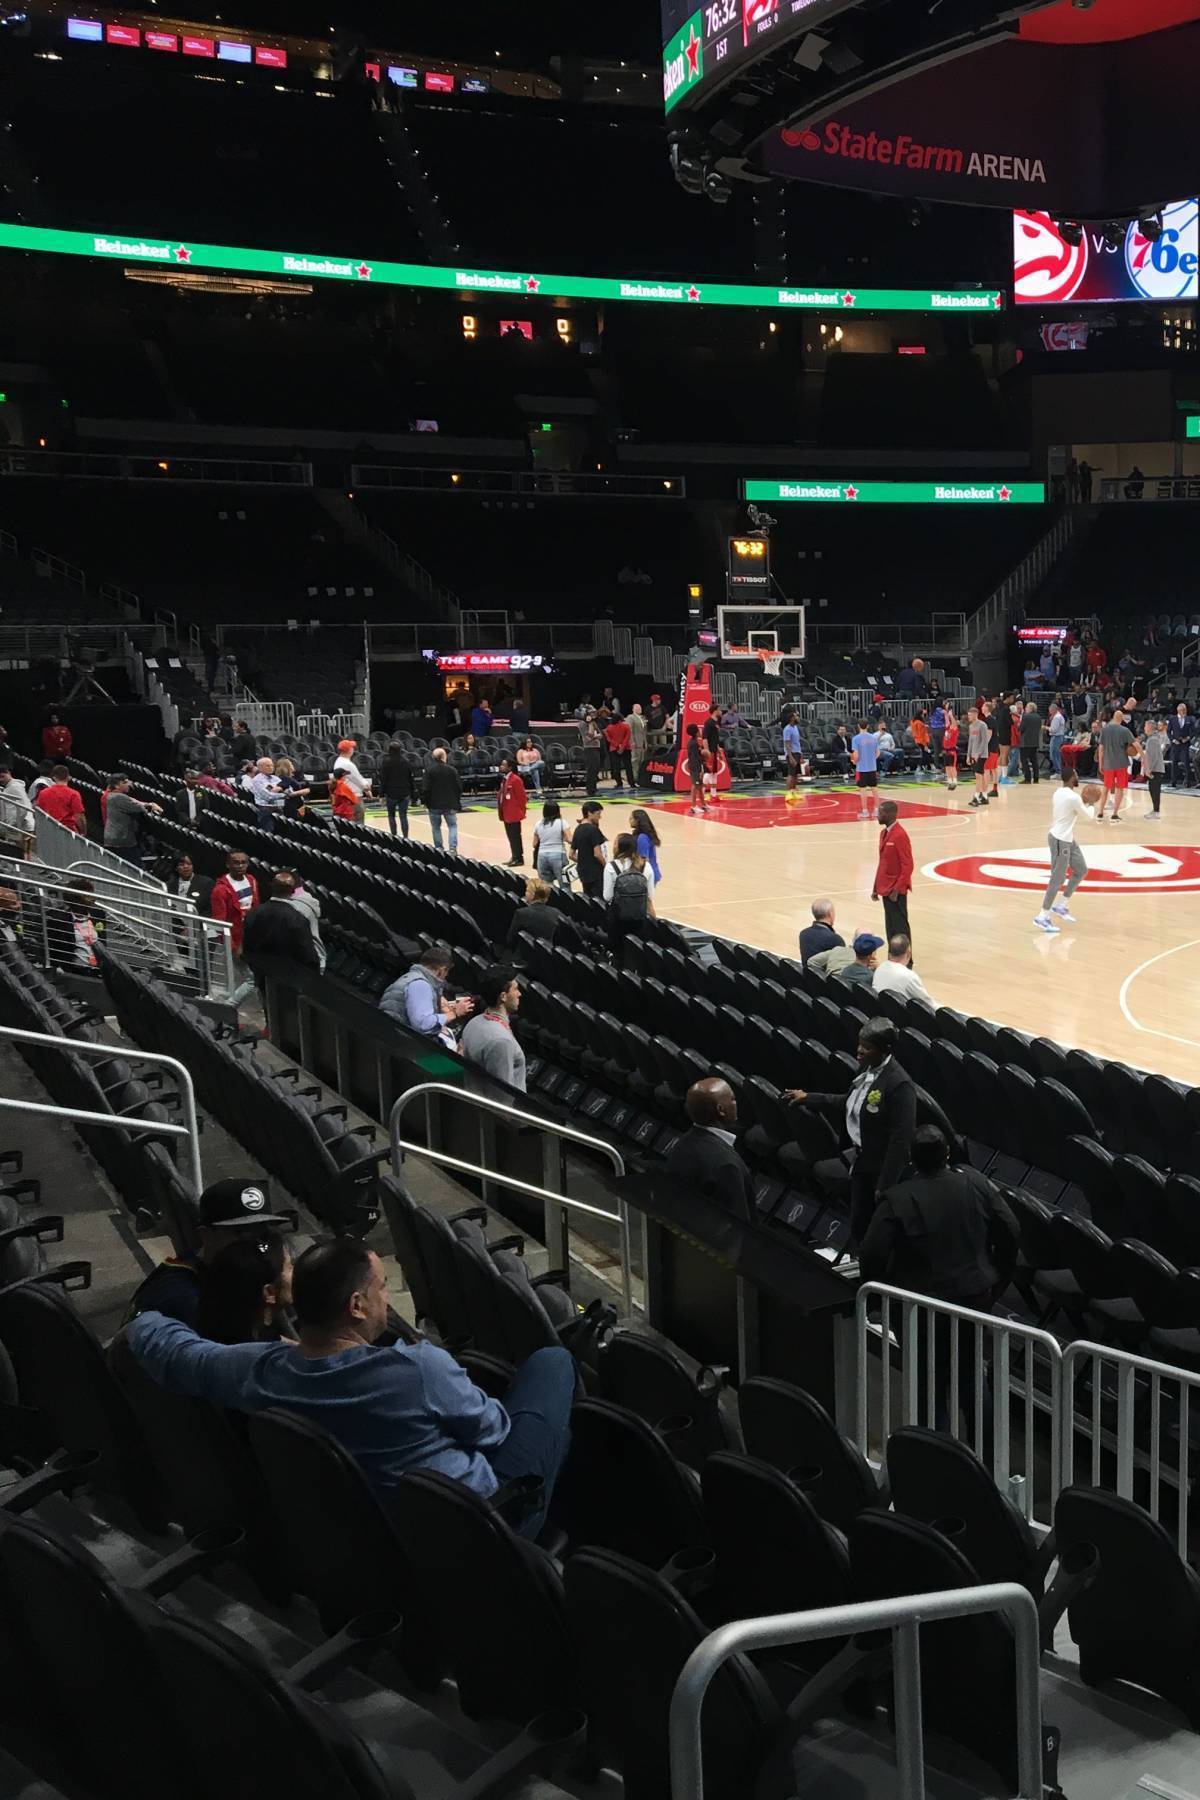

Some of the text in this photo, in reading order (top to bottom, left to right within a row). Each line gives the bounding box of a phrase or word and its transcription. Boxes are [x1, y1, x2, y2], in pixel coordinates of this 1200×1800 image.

[757, 16, 772, 32] FOULS
[716, 38, 728, 60] 1ST
[966, 152, 1047, 183] ARENA
[94, 238, 171, 258] Heineken
[283, 256, 353, 275] Heineken
[456, 272, 522, 290] Heineken
[620, 283, 683, 299] Heineken
[778, 291, 839, 304] Heineken
[931, 294, 990, 307] Heineken
[779, 485, 841, 498] Heineken
[935, 486, 996, 499] Heineken
[440, 656, 466, 664] THE
[470, 656, 509, 664] GAME
[692, 702, 707, 710] KIA
